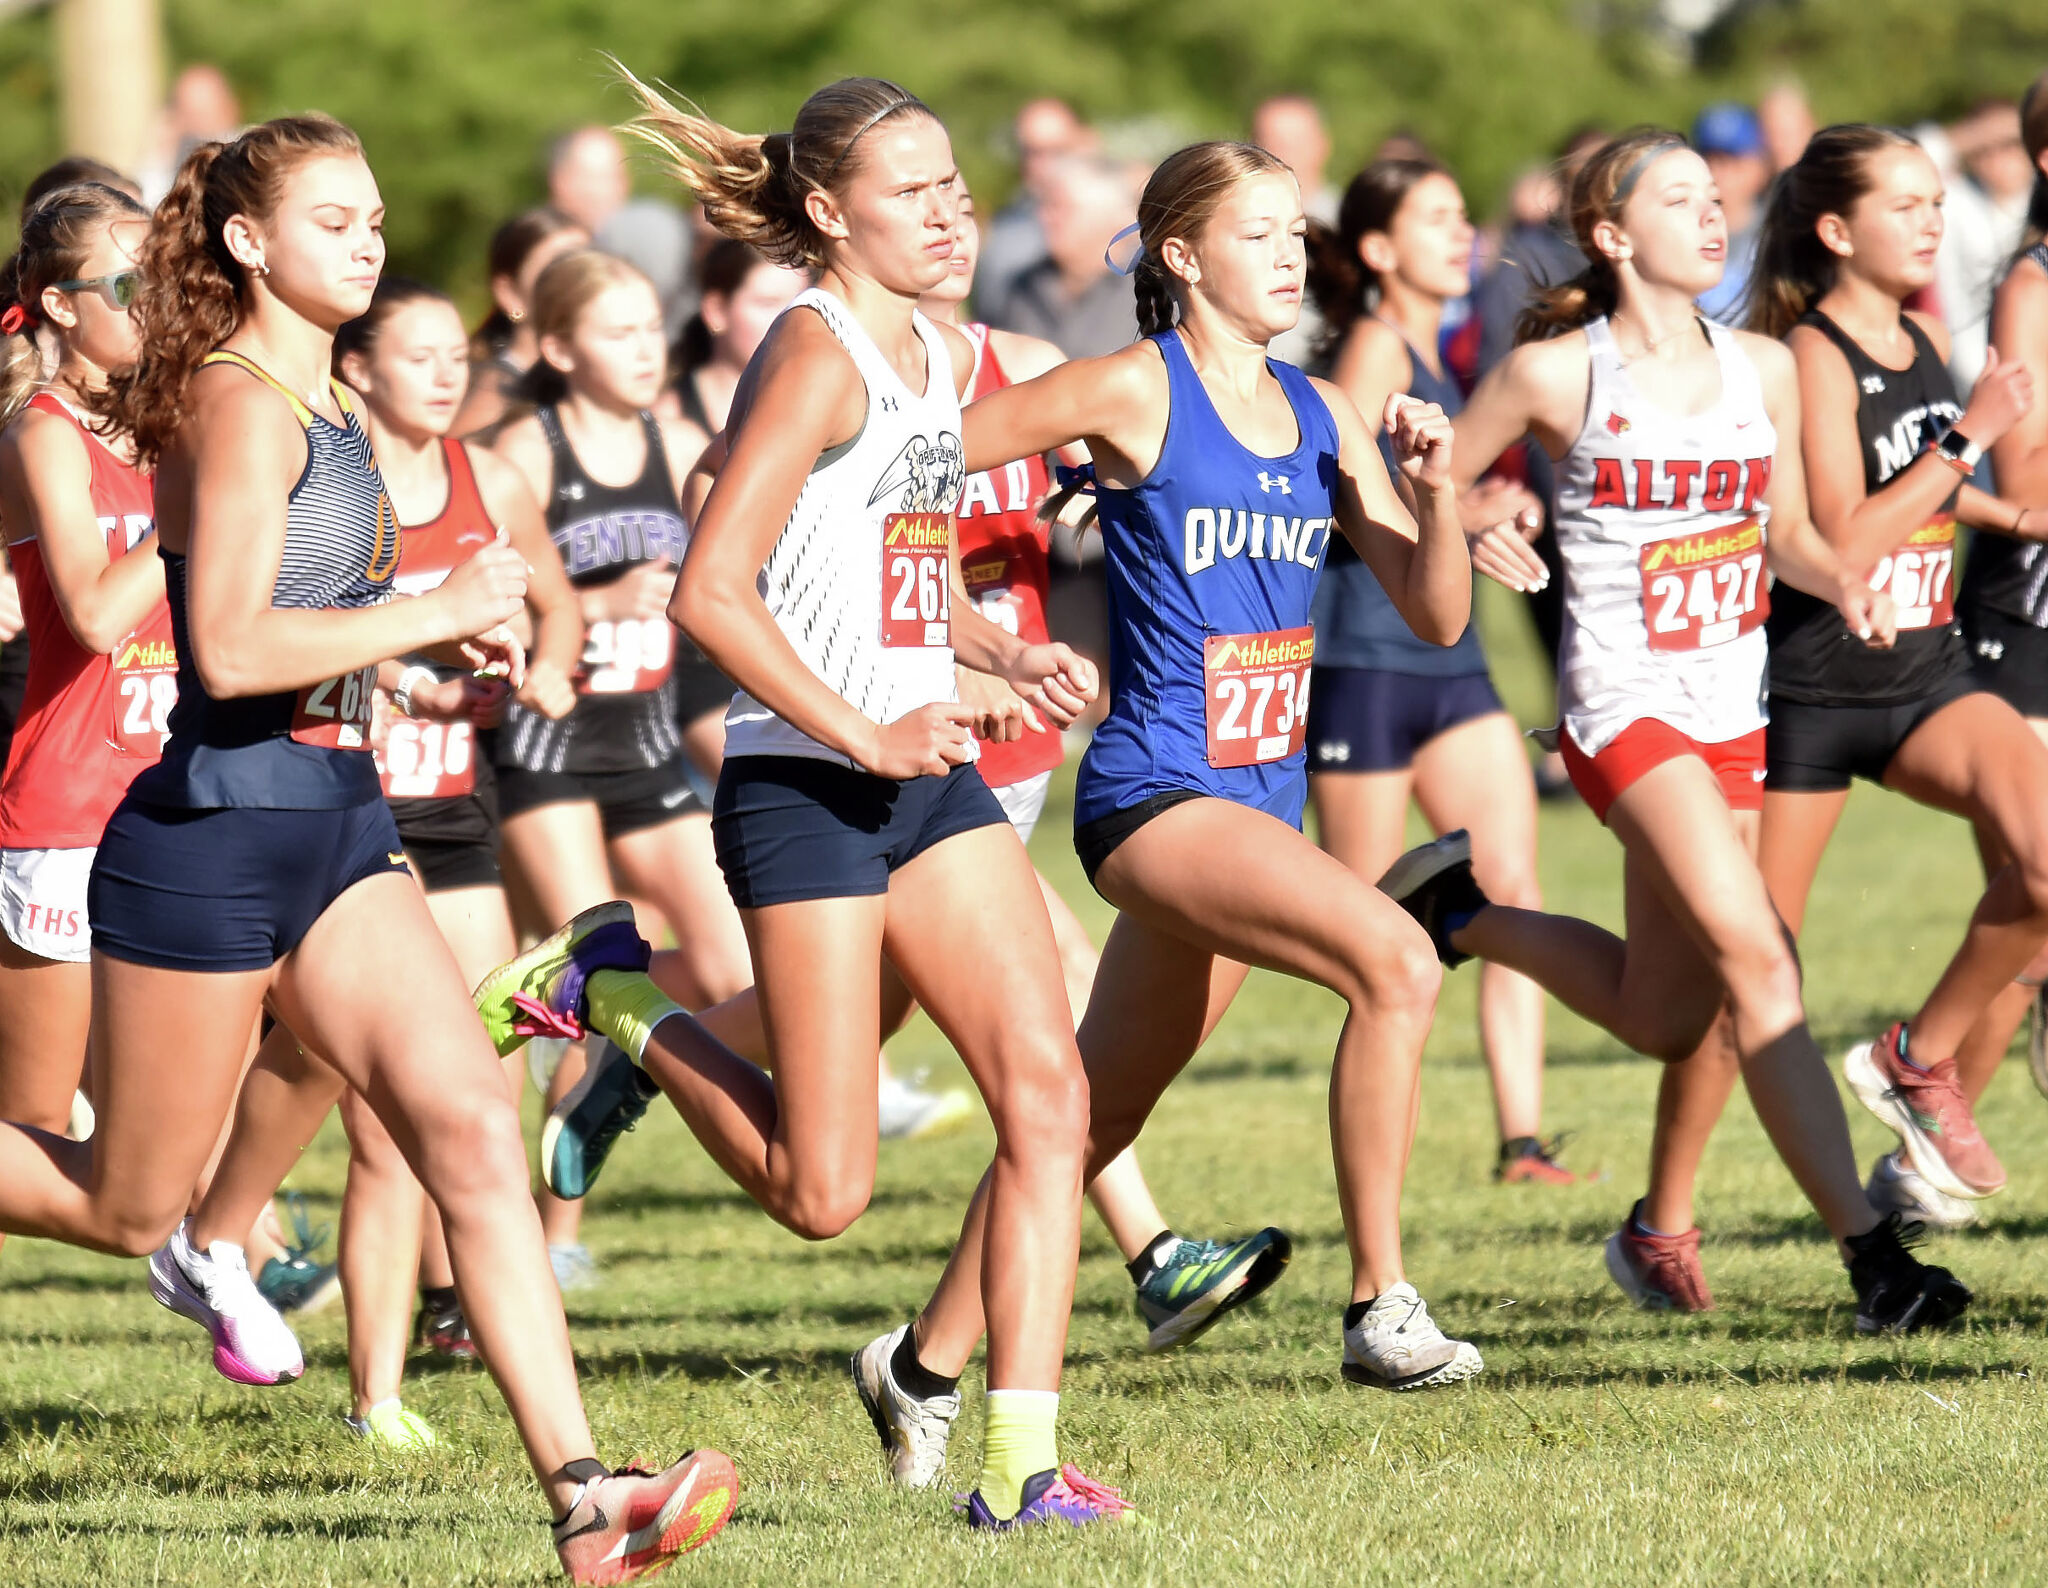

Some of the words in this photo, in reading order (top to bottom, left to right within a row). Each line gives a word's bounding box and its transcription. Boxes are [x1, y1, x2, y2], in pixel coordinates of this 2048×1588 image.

[1587, 454, 1773, 512] ALTON
[1651, 553, 1763, 634] 2427
[1215, 666, 1312, 741] 2734
[374, 721, 471, 775] 616
[26, 903, 80, 937] THS
